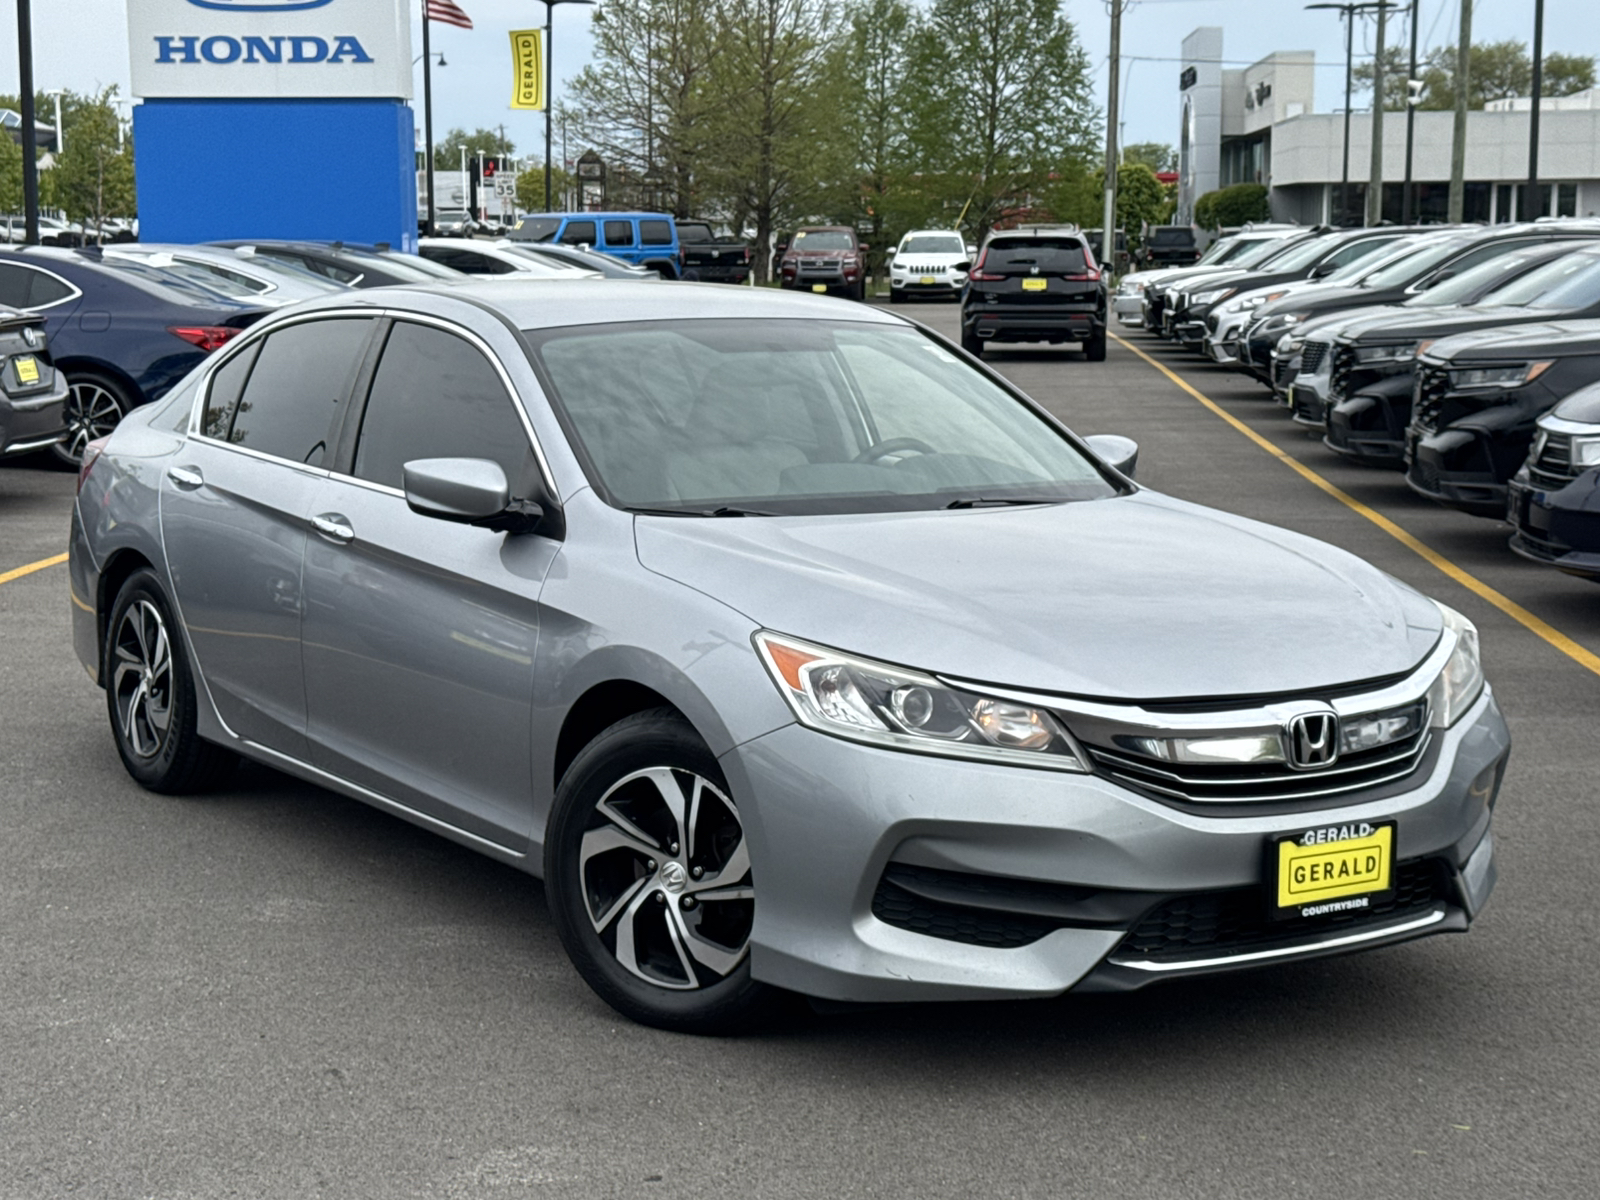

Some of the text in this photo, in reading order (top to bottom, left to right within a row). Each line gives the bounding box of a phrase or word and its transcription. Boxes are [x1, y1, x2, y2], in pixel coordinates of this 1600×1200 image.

[154, 35, 374, 63] HONDA
[522, 39, 533, 99] GERALD
[497, 185, 514, 195] 35
[1304, 823, 1370, 845] GERALD
[1294, 855, 1376, 884] GERALD
[1302, 898, 1369, 917] COUNTRYSIDE
